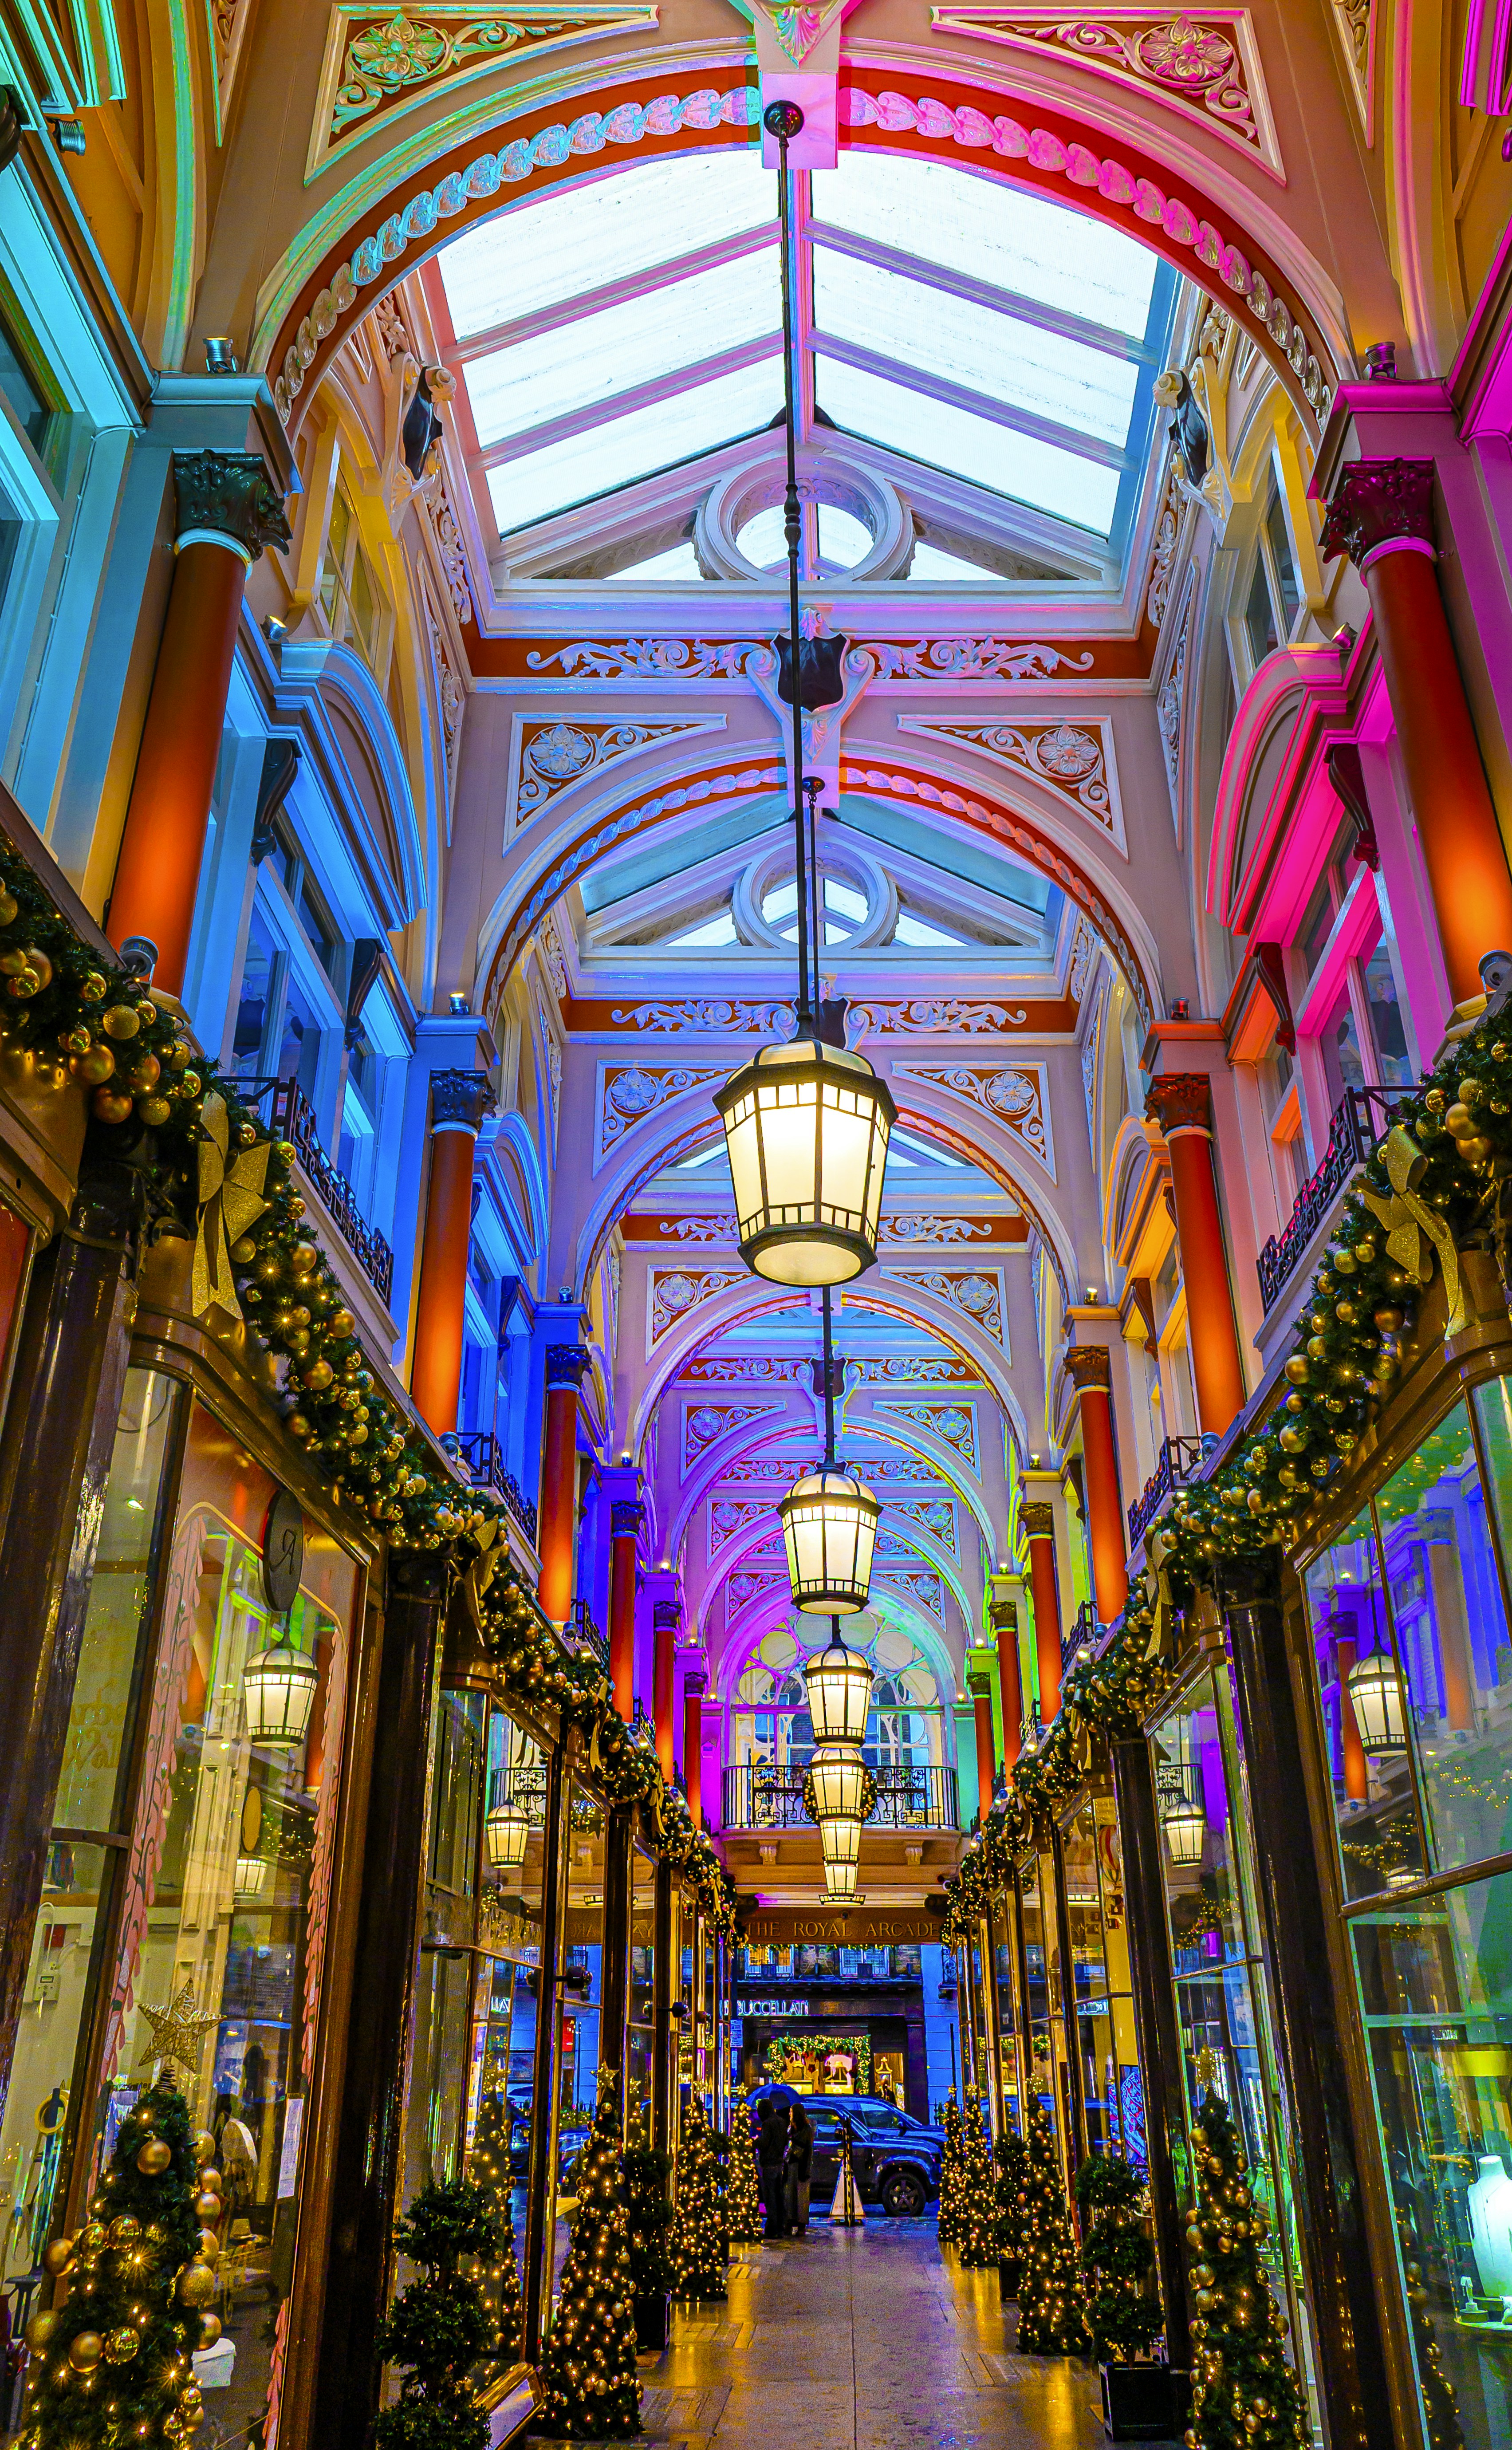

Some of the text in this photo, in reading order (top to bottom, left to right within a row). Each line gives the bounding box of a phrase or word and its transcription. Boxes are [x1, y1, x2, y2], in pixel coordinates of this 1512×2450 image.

[745, 1922, 940, 1937] THE ROYAL ARCADE
